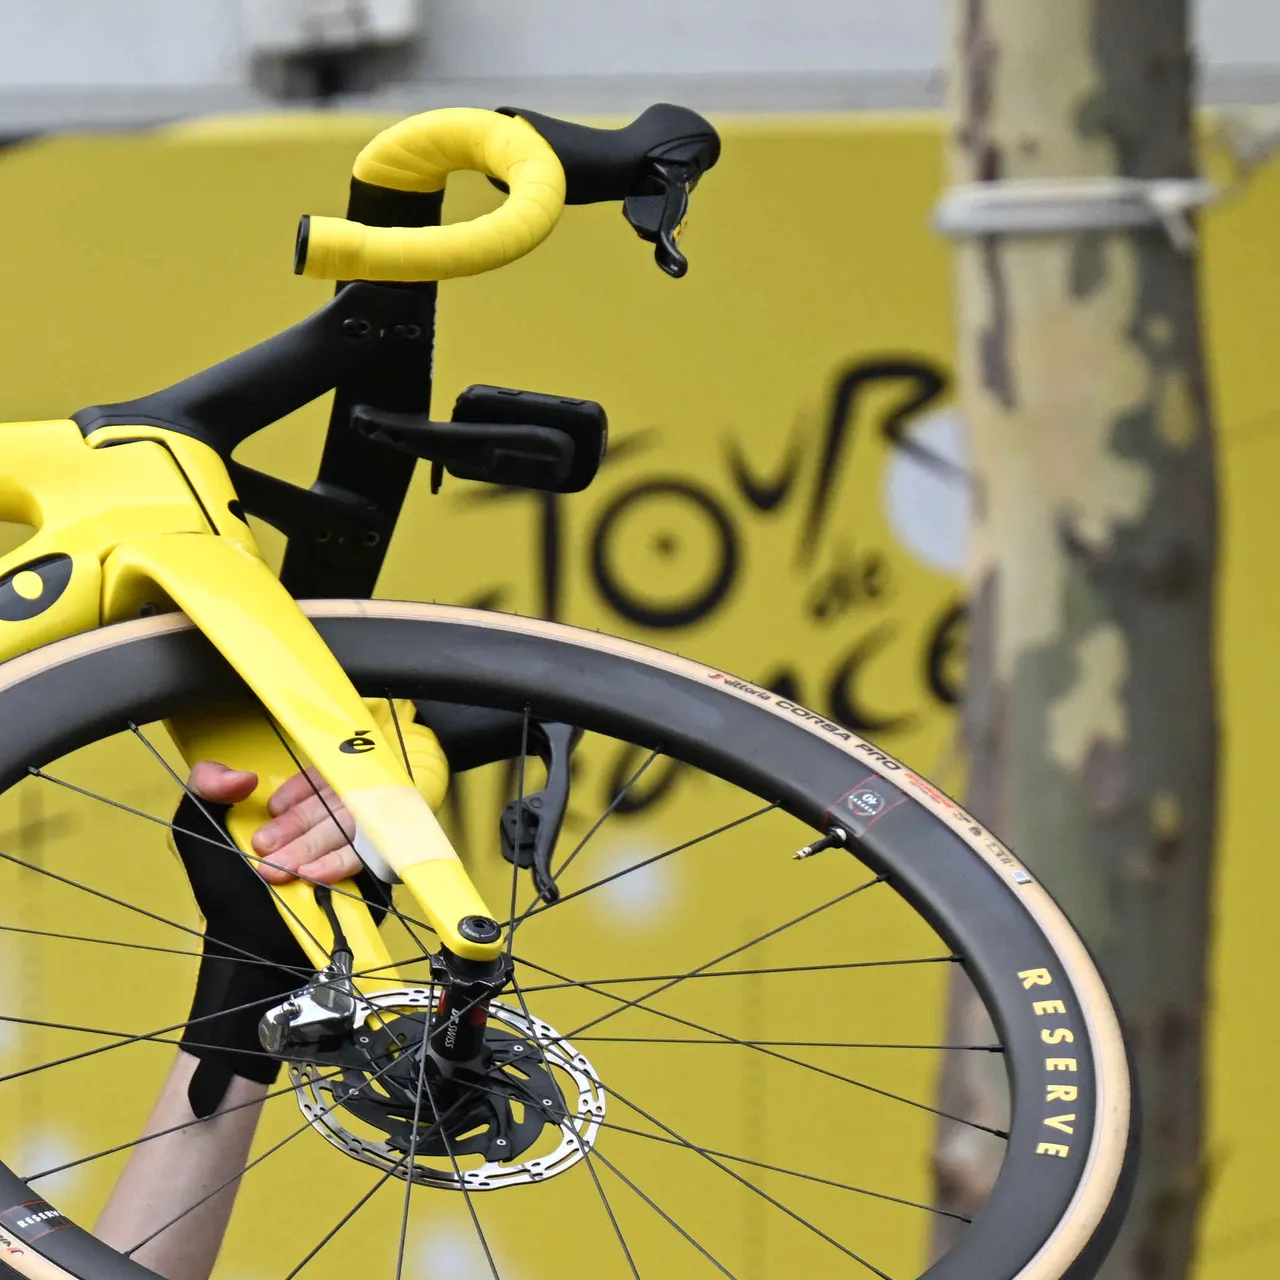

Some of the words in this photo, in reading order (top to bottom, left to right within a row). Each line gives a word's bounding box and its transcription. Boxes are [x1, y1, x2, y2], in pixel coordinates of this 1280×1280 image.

[724, 678, 772, 701] vittoria
[775, 699, 852, 742] CORSA
[855, 743, 902, 771] PRO
[1016, 967, 1080, 1161] RESERVE
[17, 1210, 61, 1228] RESERV
